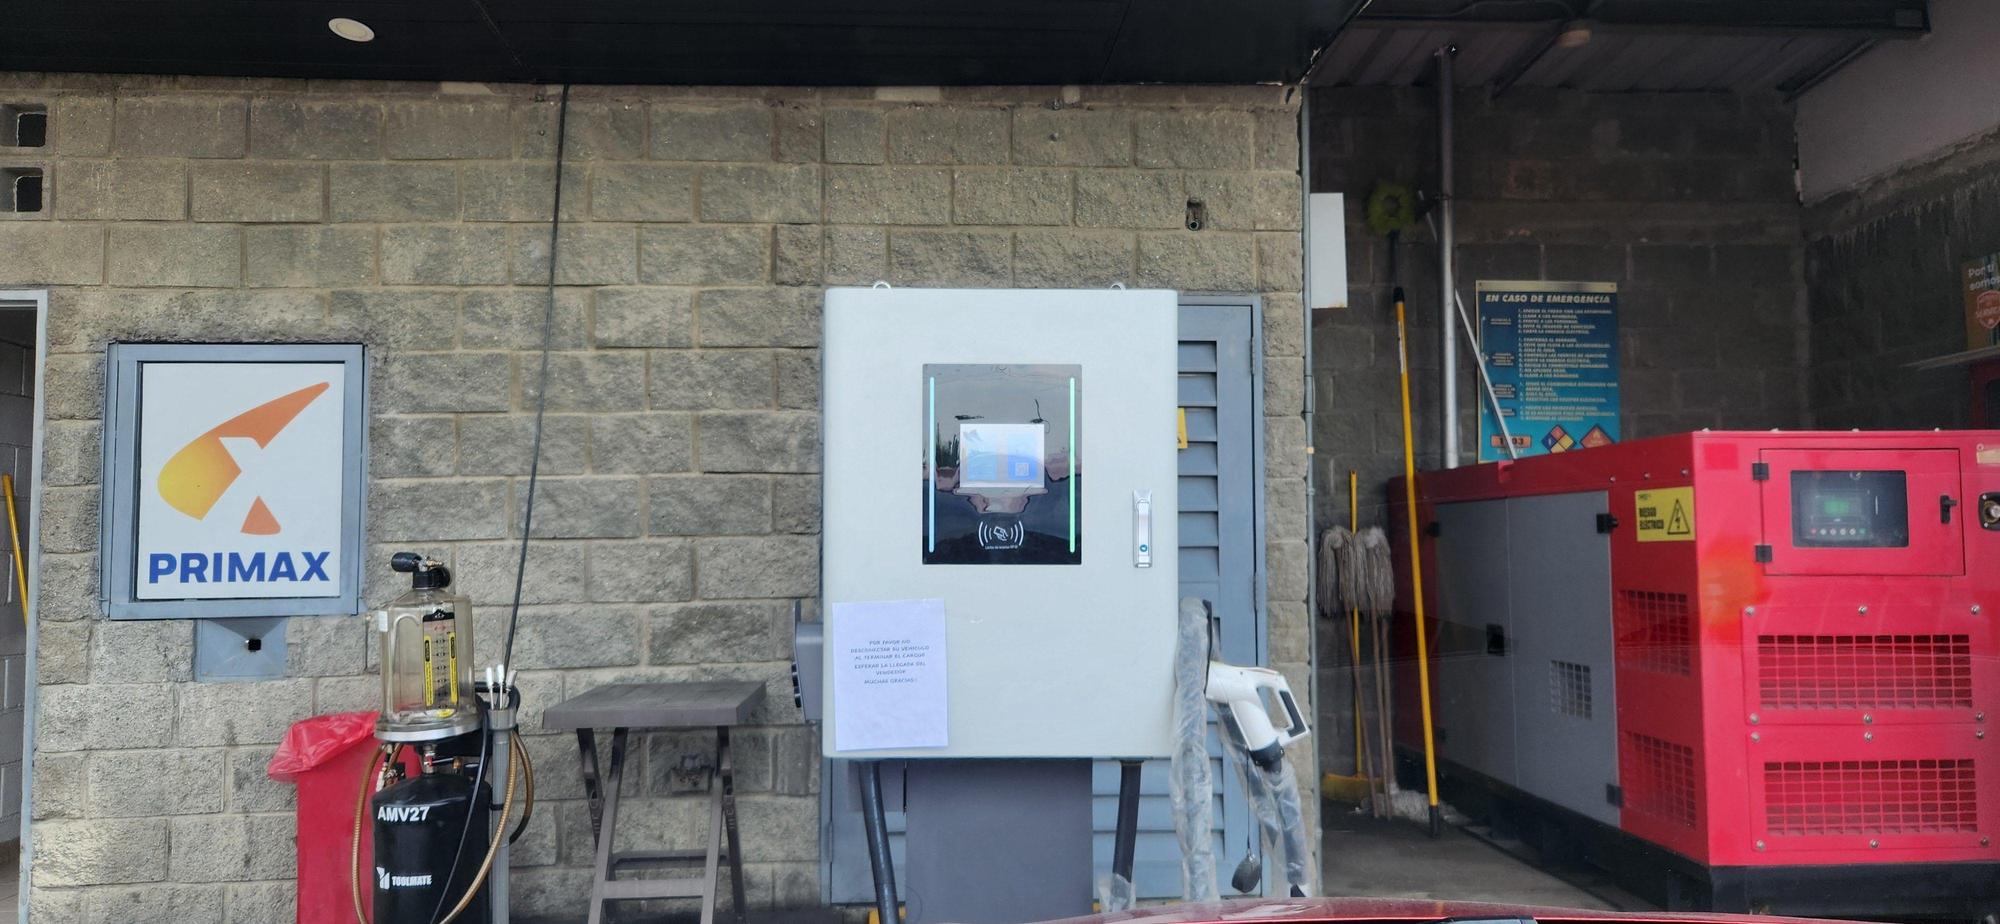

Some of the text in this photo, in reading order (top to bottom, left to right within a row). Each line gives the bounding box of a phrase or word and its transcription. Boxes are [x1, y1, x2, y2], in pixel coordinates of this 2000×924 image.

[1485, 294, 1611, 304] EN CASO DE EMERGENCIA
[149, 551, 331, 584] PRIMAX
[377, 806, 431, 822] AMV27
[391, 875, 433, 887] TOOLMATE
